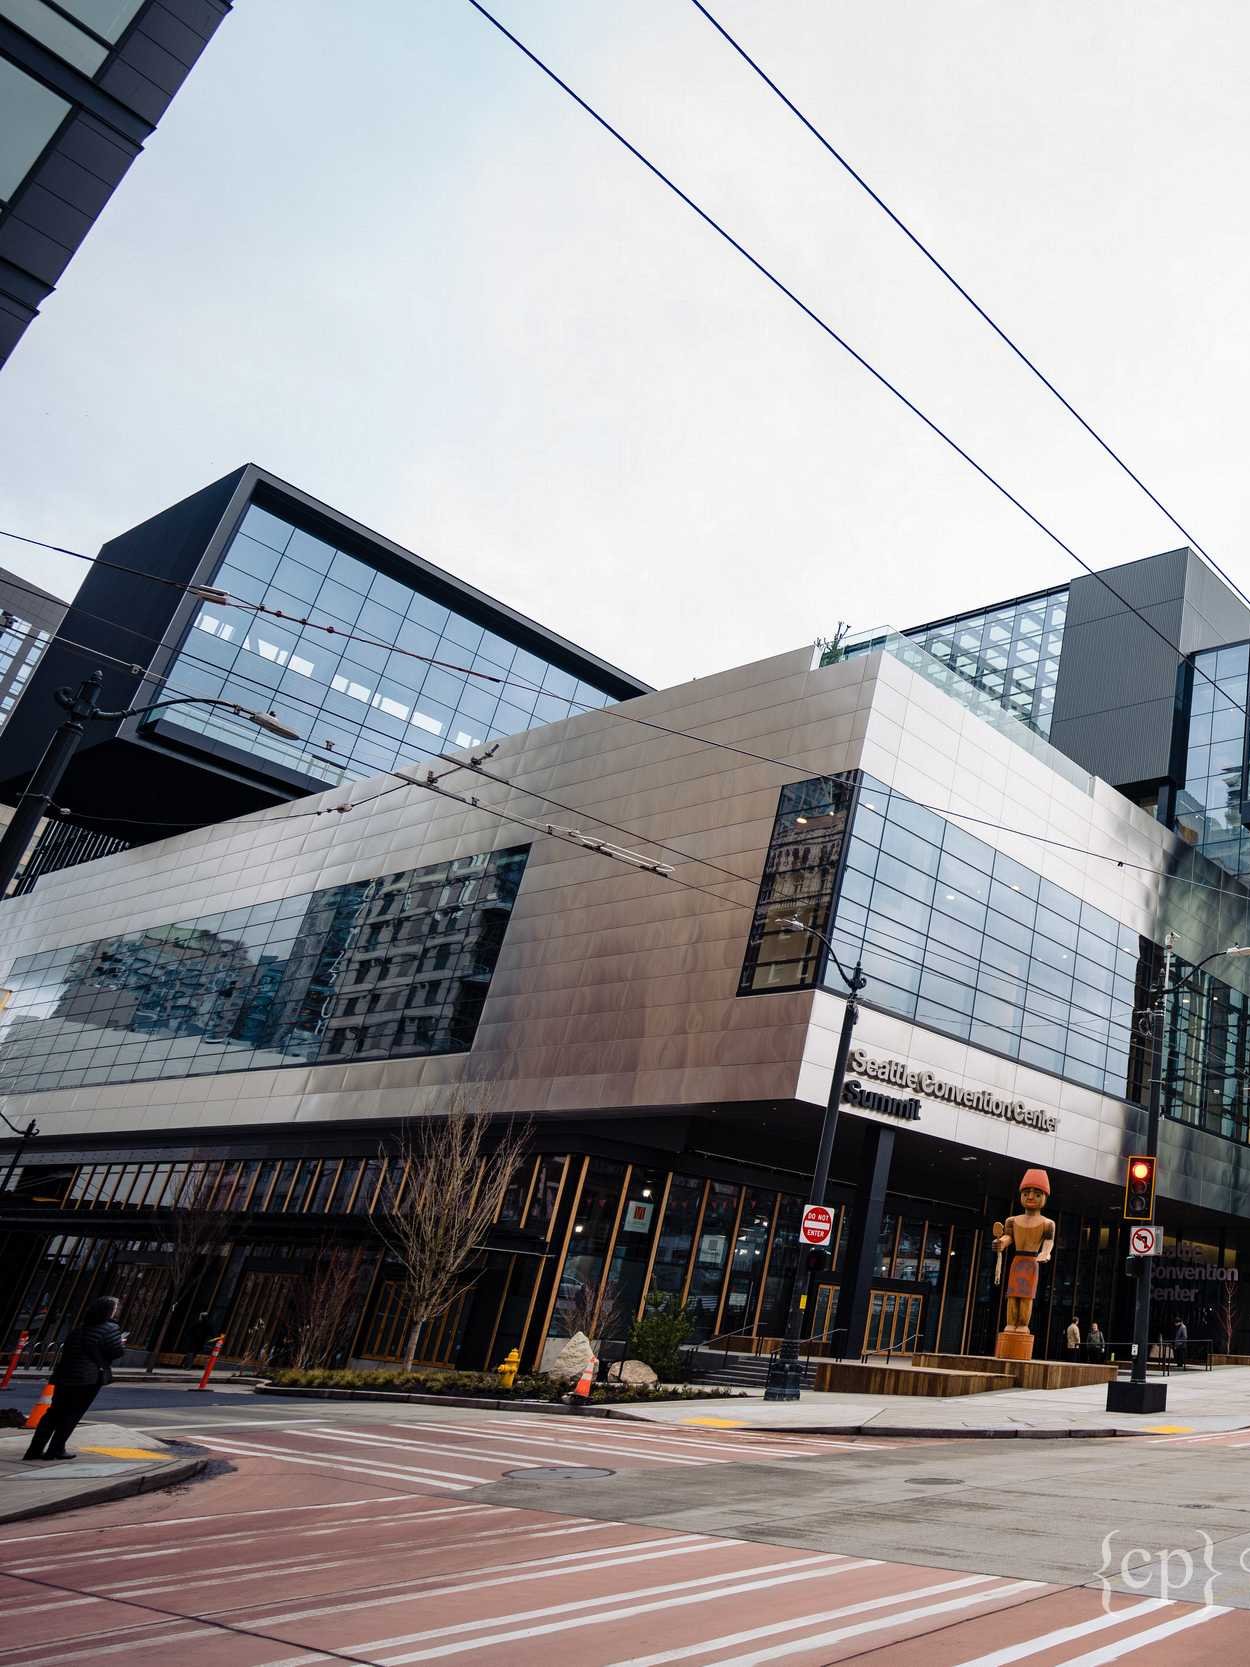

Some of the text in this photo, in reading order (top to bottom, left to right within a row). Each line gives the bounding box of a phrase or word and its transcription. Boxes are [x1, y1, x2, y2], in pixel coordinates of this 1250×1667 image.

[842, 1079, 922, 1121] Summit
[849, 1048, 1060, 1132] Seattle Convention Center
[807, 1212, 816, 1220] DO
